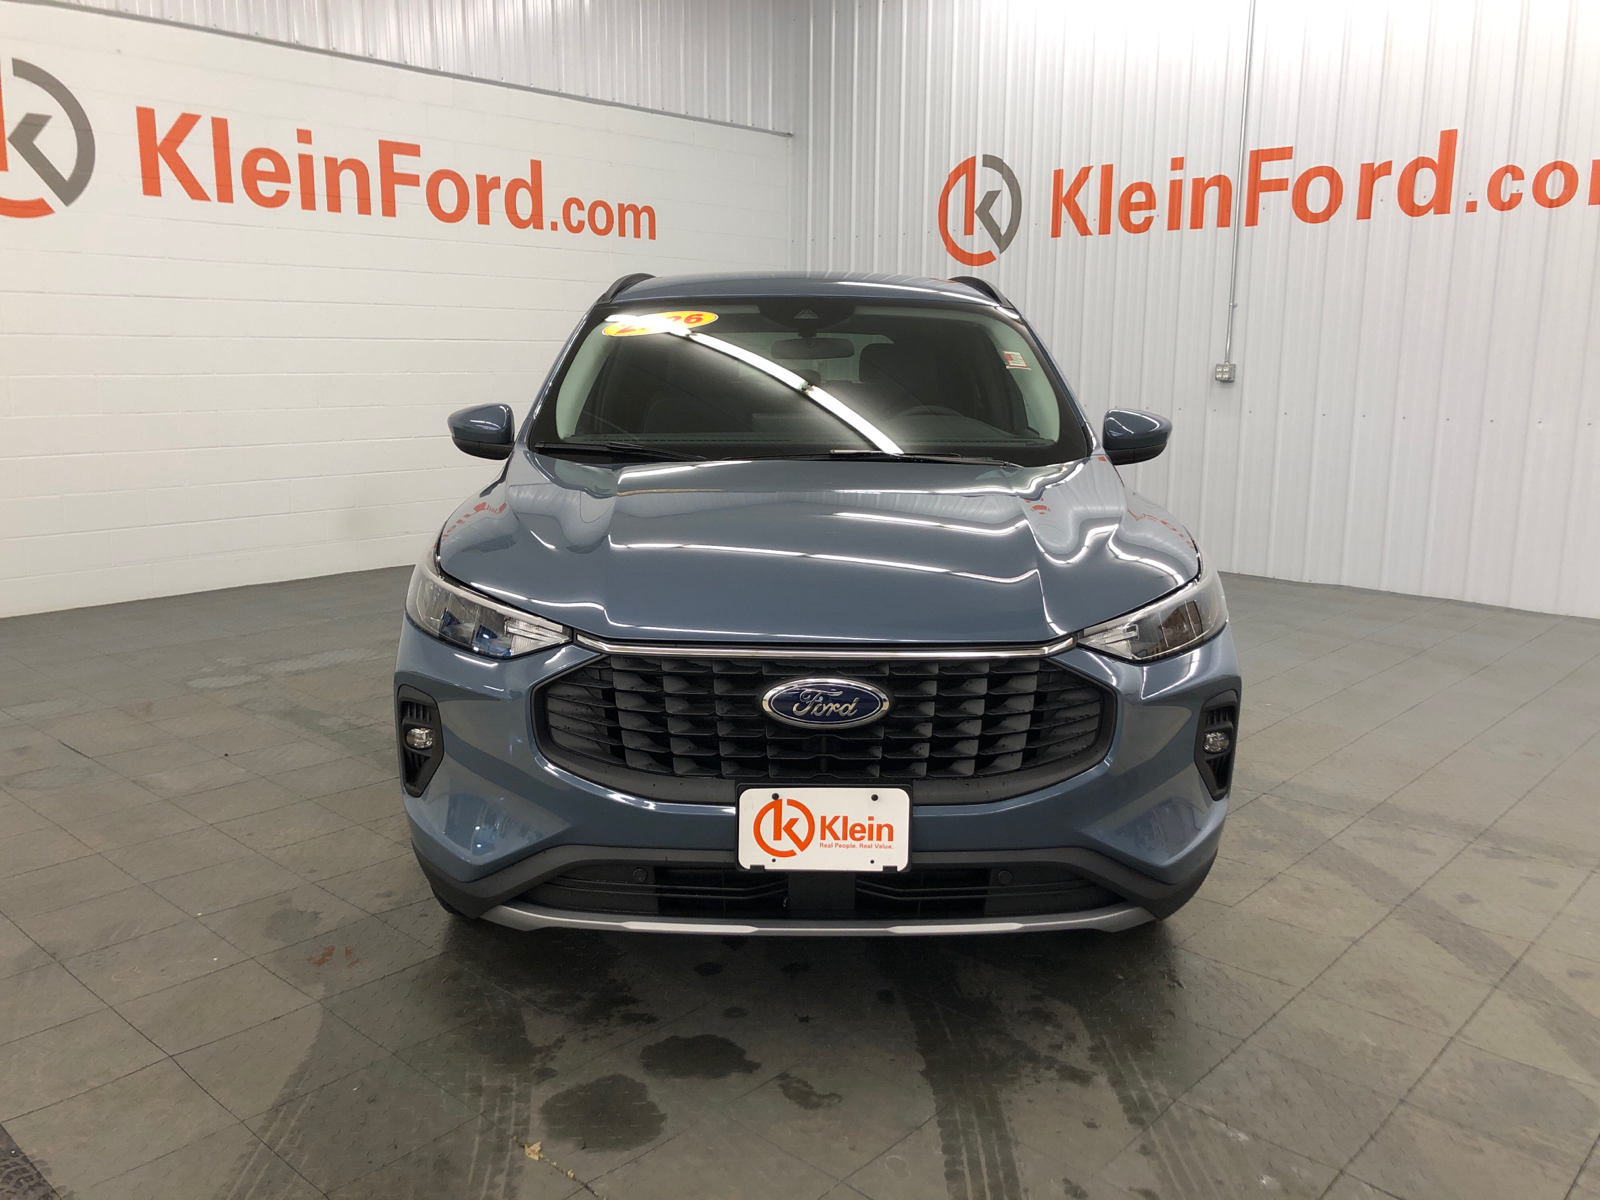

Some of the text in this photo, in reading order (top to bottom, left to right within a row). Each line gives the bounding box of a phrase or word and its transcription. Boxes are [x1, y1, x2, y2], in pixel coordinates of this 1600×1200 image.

[135, 106, 657, 241] KleinFord.com
[1050, 129, 1600, 238] KleinFord.co
[792, 688, 860, 717] Ford
[820, 815, 895, 842] Klein
[834, 842, 858, 850] People.
